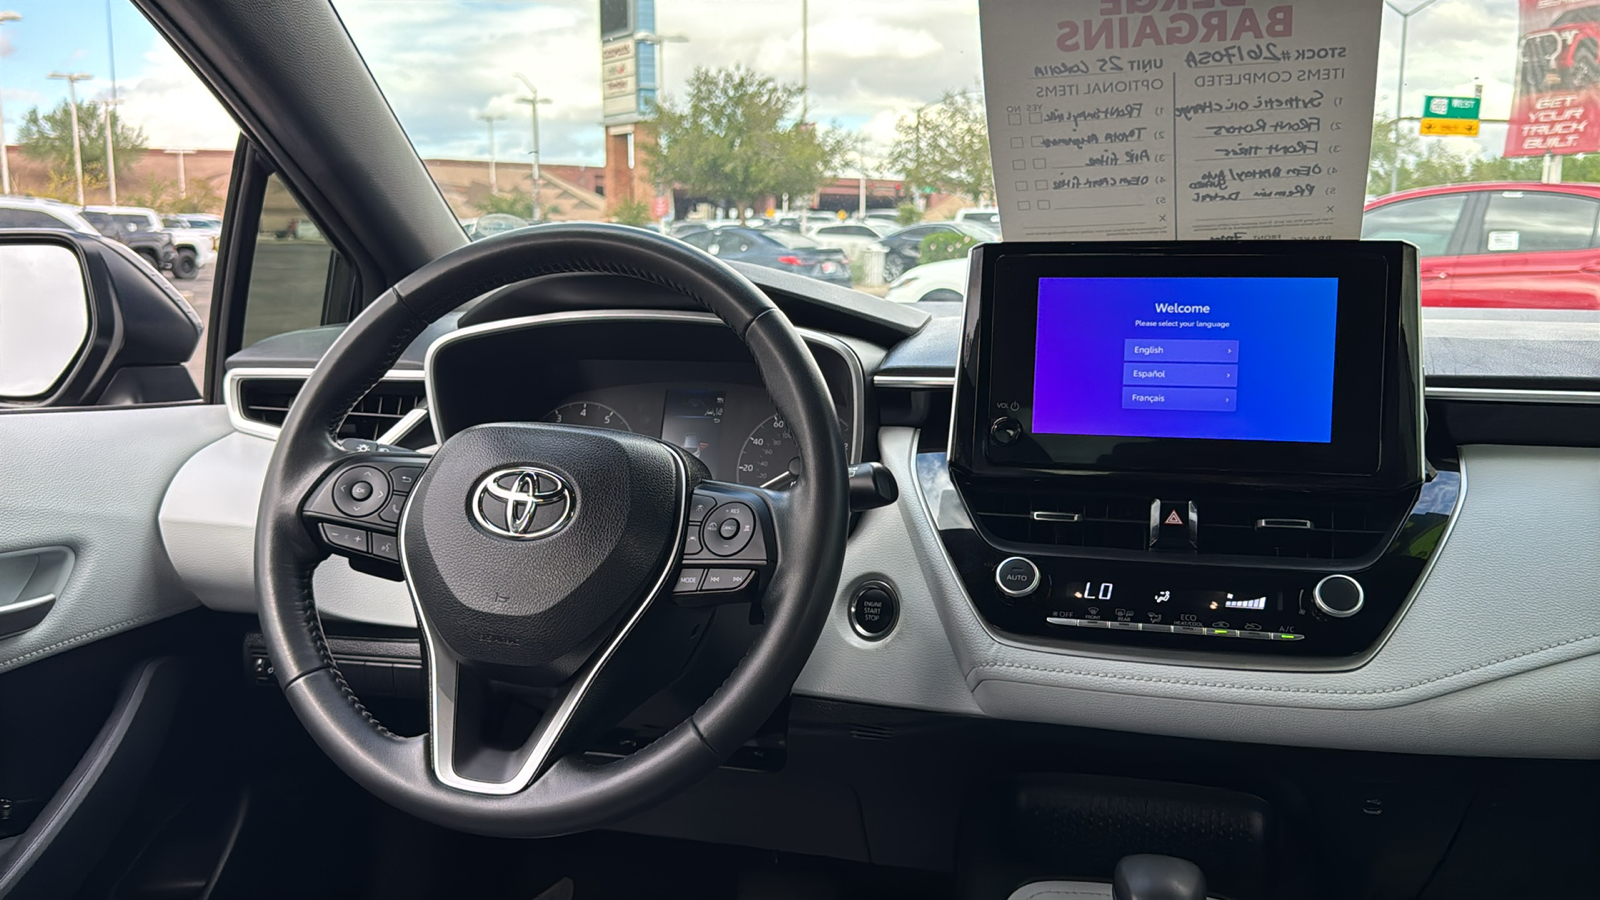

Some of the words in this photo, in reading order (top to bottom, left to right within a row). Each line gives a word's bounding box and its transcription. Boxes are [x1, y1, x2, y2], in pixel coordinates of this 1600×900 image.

[1535, 95, 1577, 109] GET
[1529, 107, 1584, 122] YOUR
[1521, 121, 1587, 137] TRUCK
[1155, 302, 1211, 314] Welcome
[1135, 319, 1157, 327] Please
[1158, 319, 1179, 328] select
[1180, 321, 1195, 329] your
[1196, 320, 1230, 329] language
[1134, 346, 1164, 356] English
[1133, 370, 1166, 379] Español
[1132, 393, 1165, 404] Français
[580, 409, 587, 417] 4
[556, 414, 562, 423] 3
[604, 415, 611, 424] 5
[773, 420, 784, 428] 60
[752, 438, 764, 446] 40
[742, 464, 754, 472] 20
